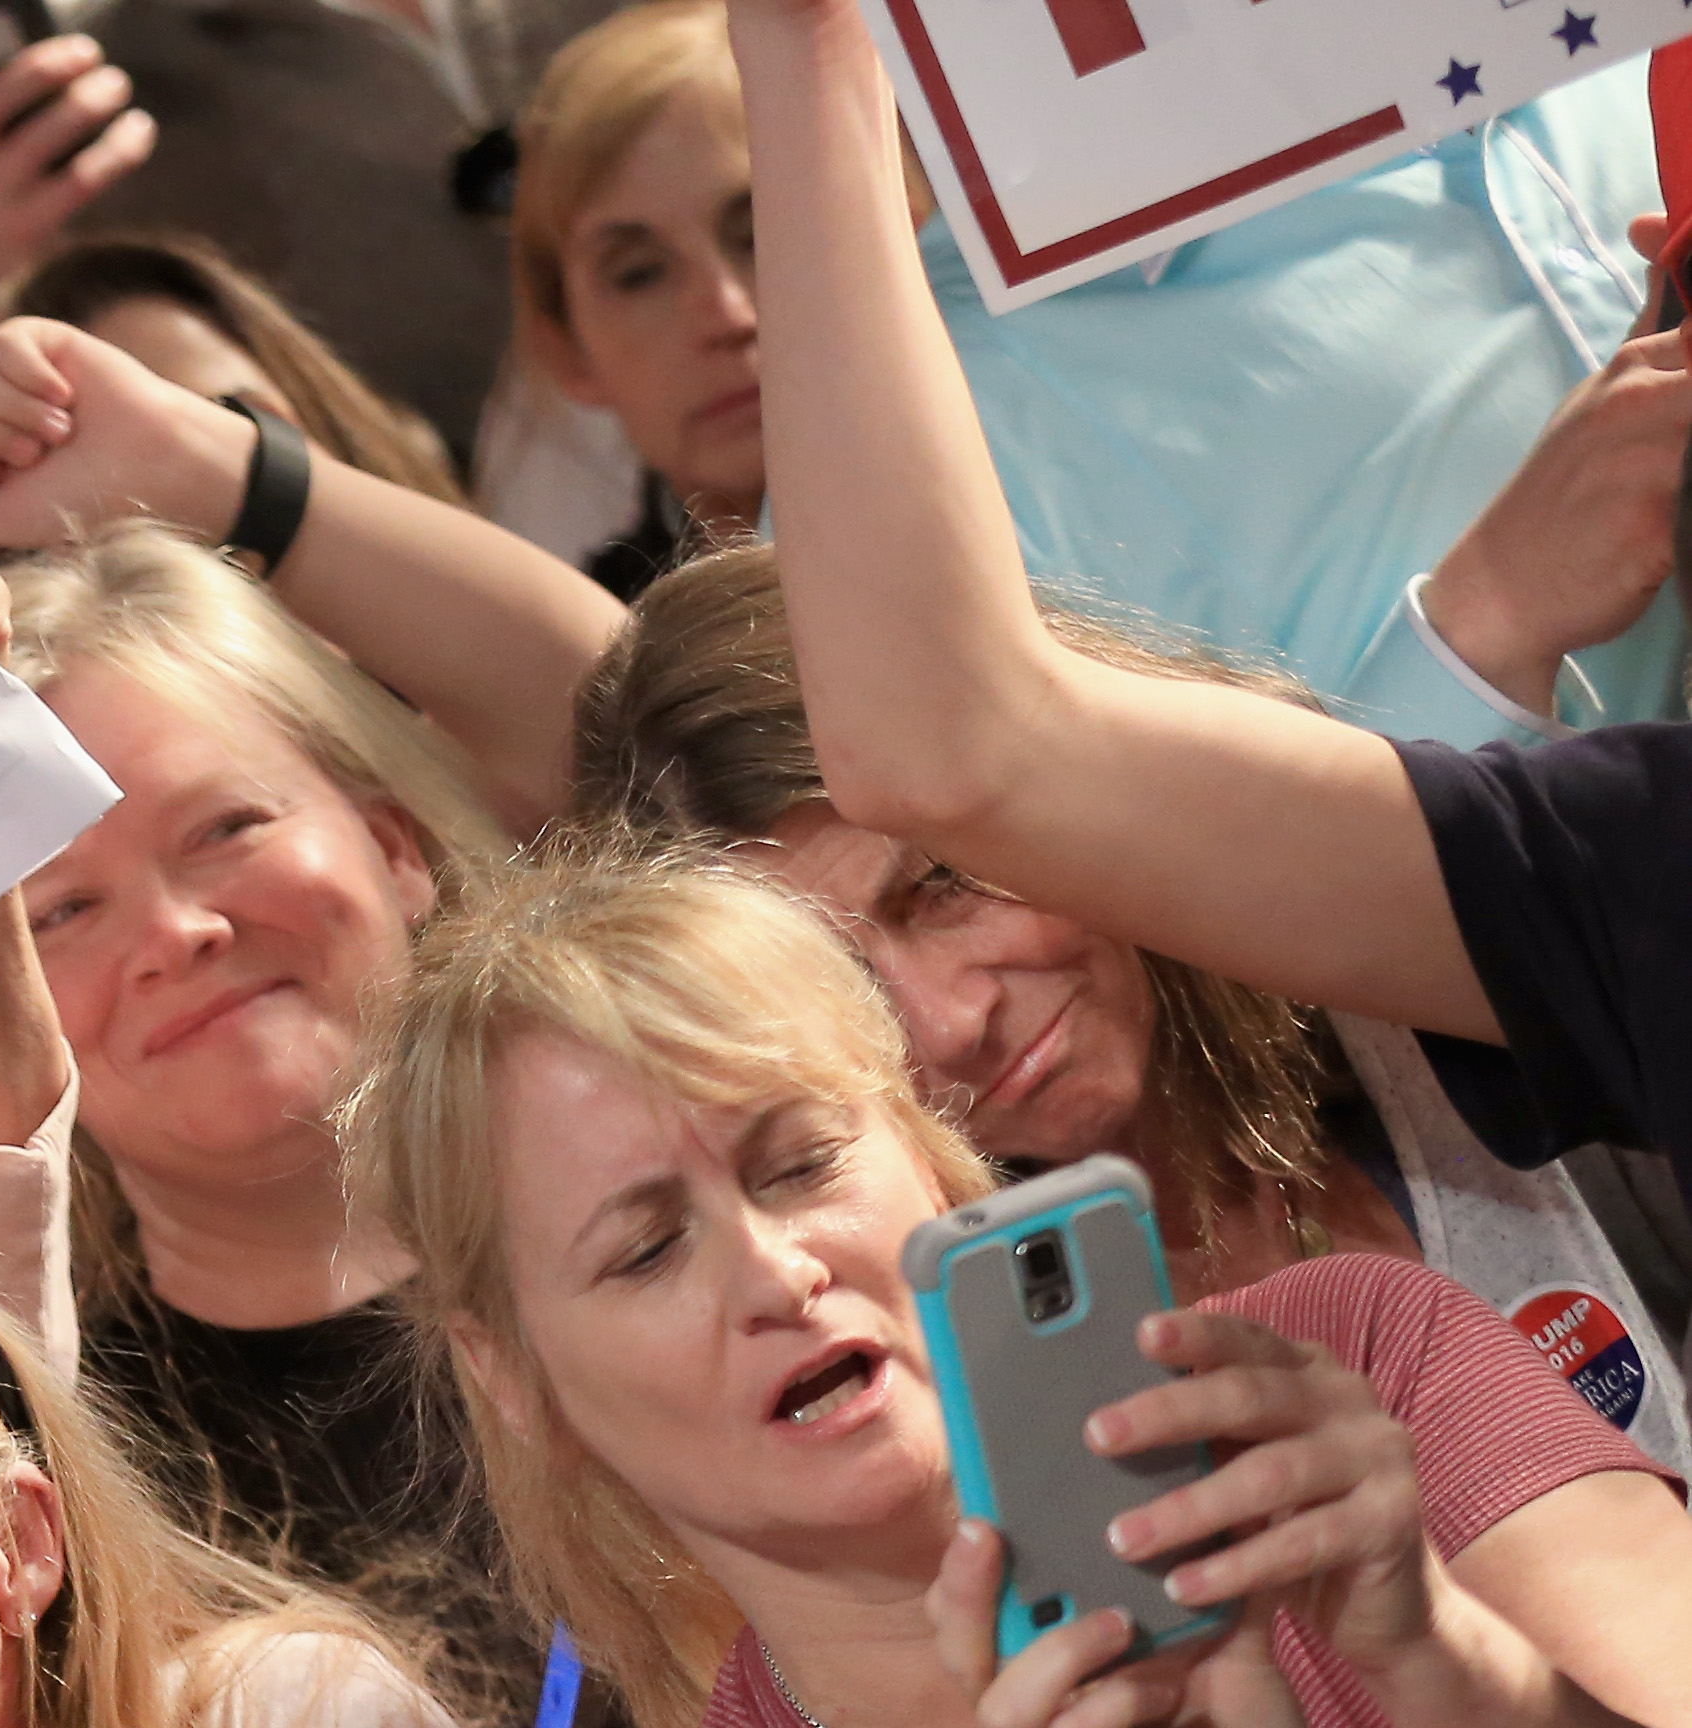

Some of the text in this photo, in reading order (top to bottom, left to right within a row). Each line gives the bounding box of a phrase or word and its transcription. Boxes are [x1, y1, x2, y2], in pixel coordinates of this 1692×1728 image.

[1531, 1297, 1591, 1352] UMP
[1548, 1336, 1585, 1371] 016
[1572, 1368, 1594, 1391] AKE
[1583, 1360, 1640, 1408] RICA
